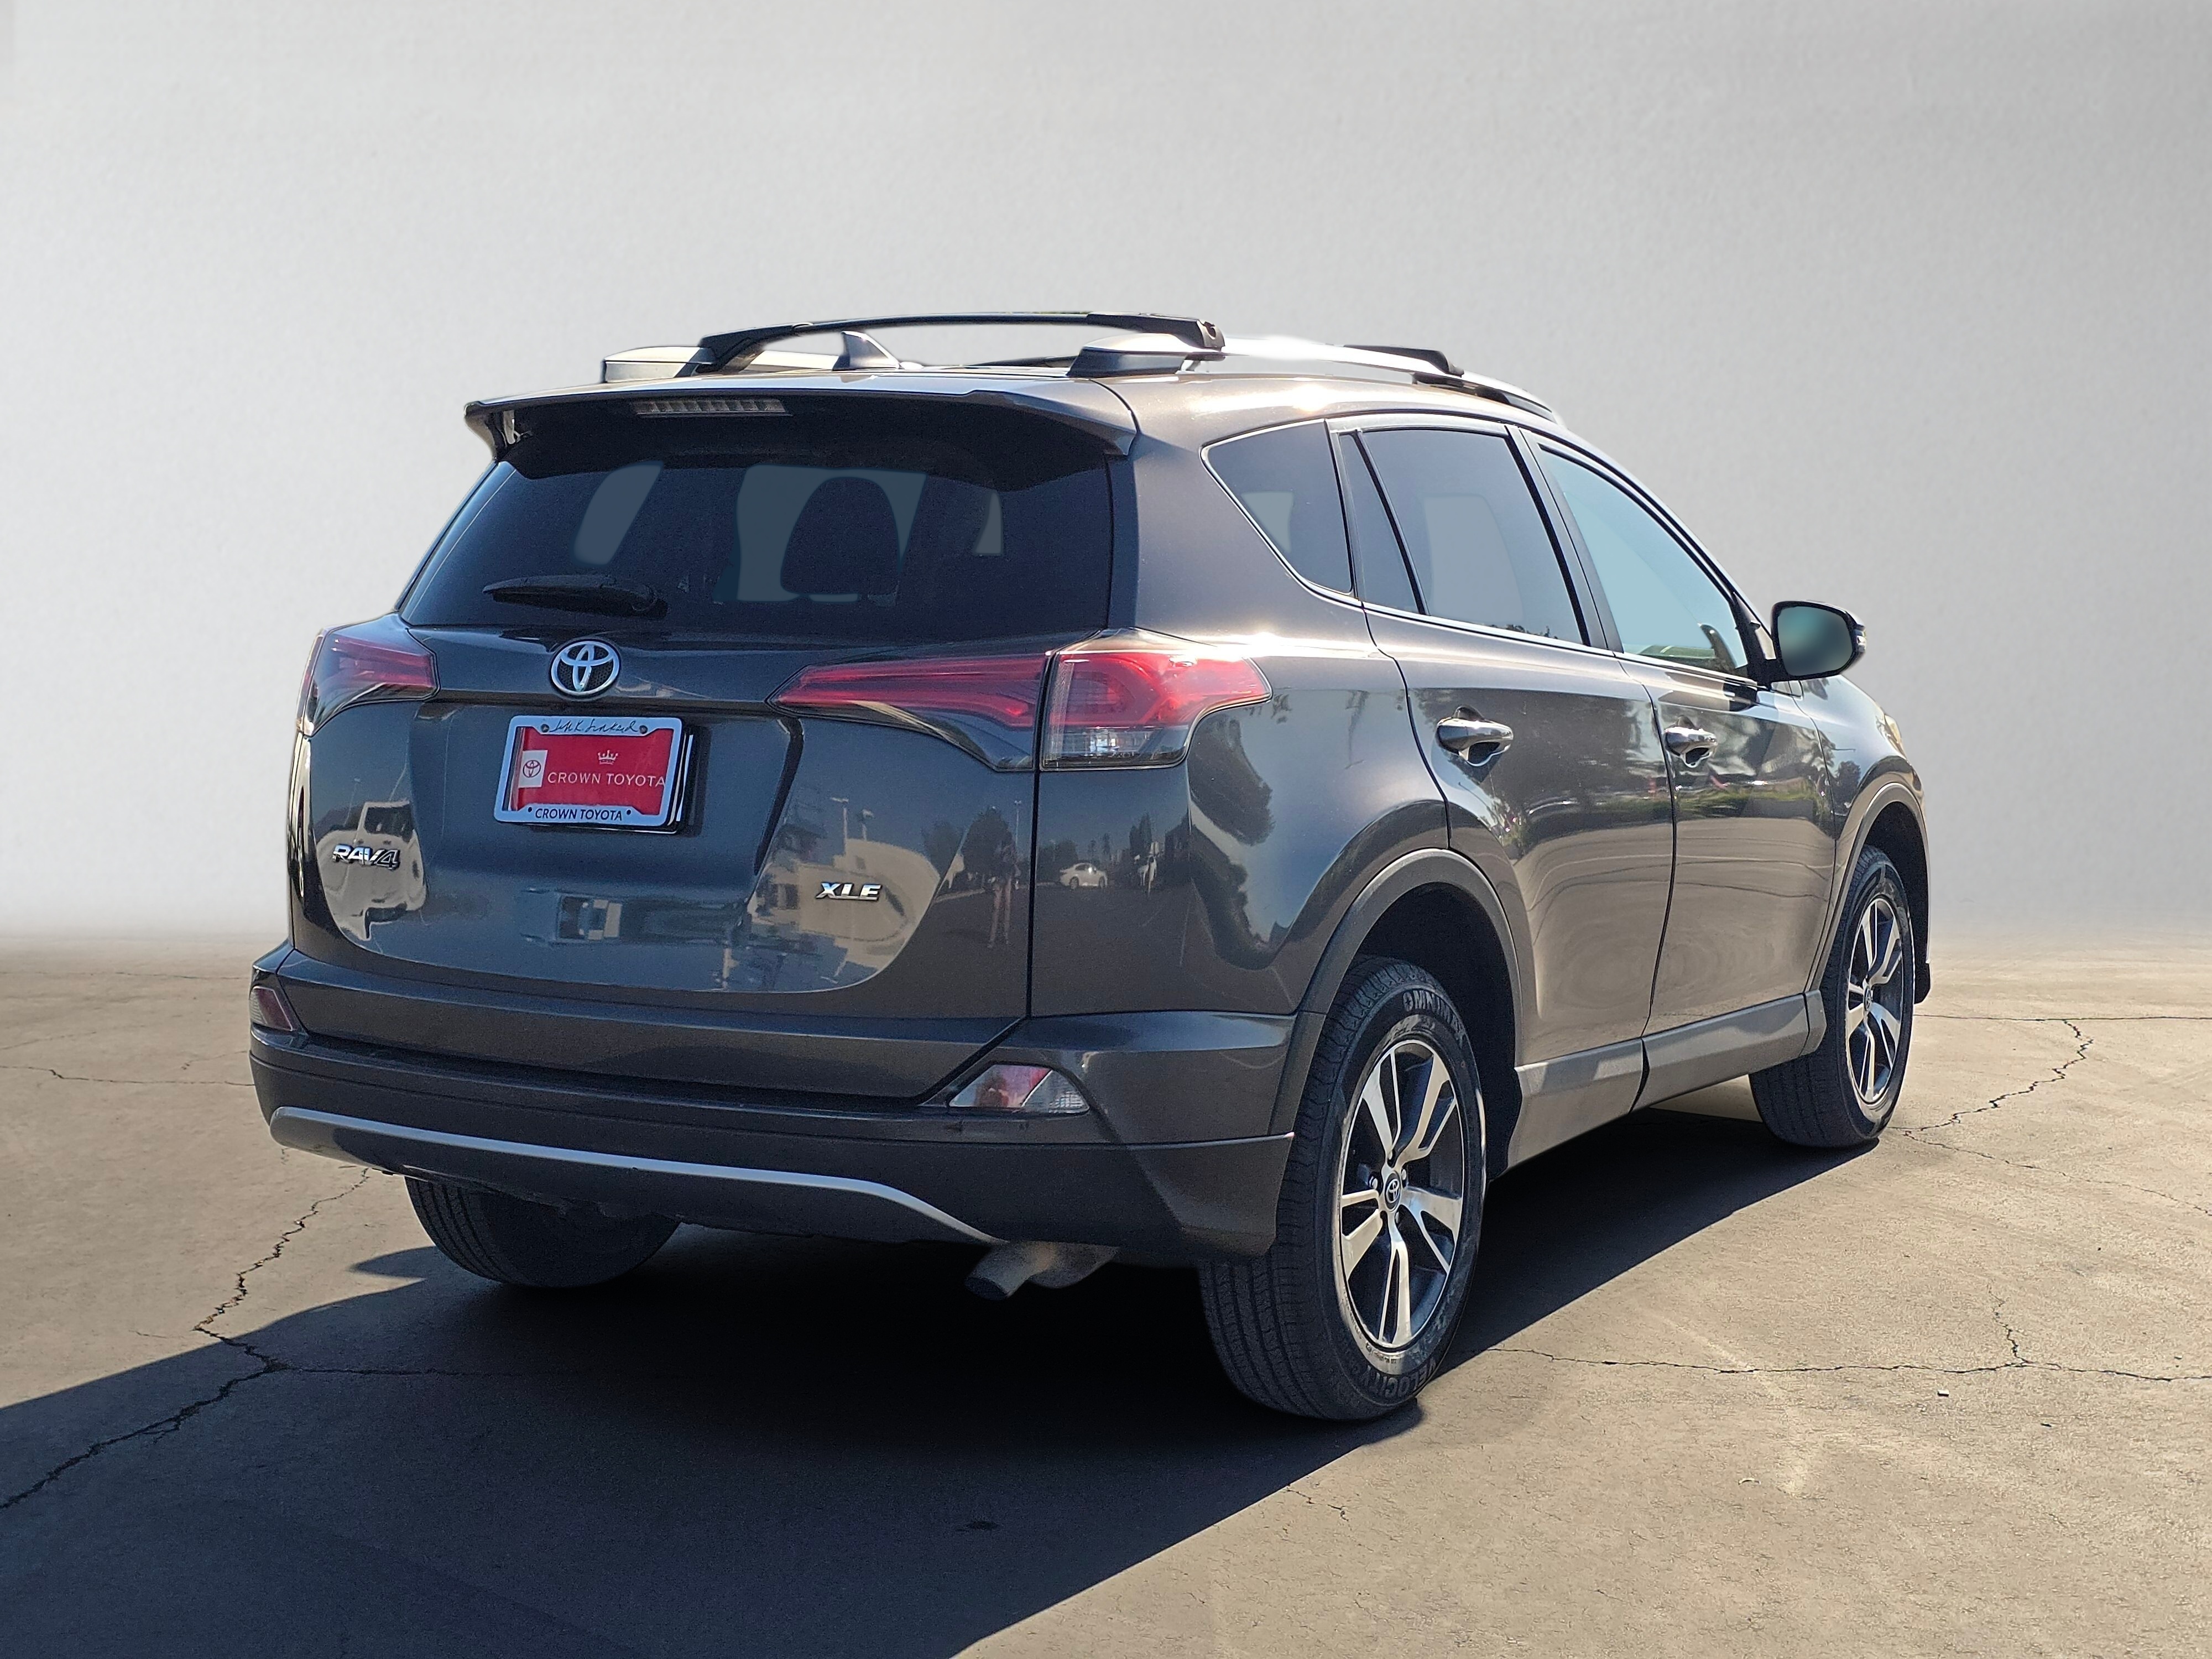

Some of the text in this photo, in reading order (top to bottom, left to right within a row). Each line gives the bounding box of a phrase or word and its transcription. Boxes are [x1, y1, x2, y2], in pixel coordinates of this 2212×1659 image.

[547, 771, 666, 787] CROWN TOYOTA
[535, 807, 622, 821] CROWN TOYOTA
[332, 843, 400, 870] RAV4
[815, 882, 882, 901] XLE
